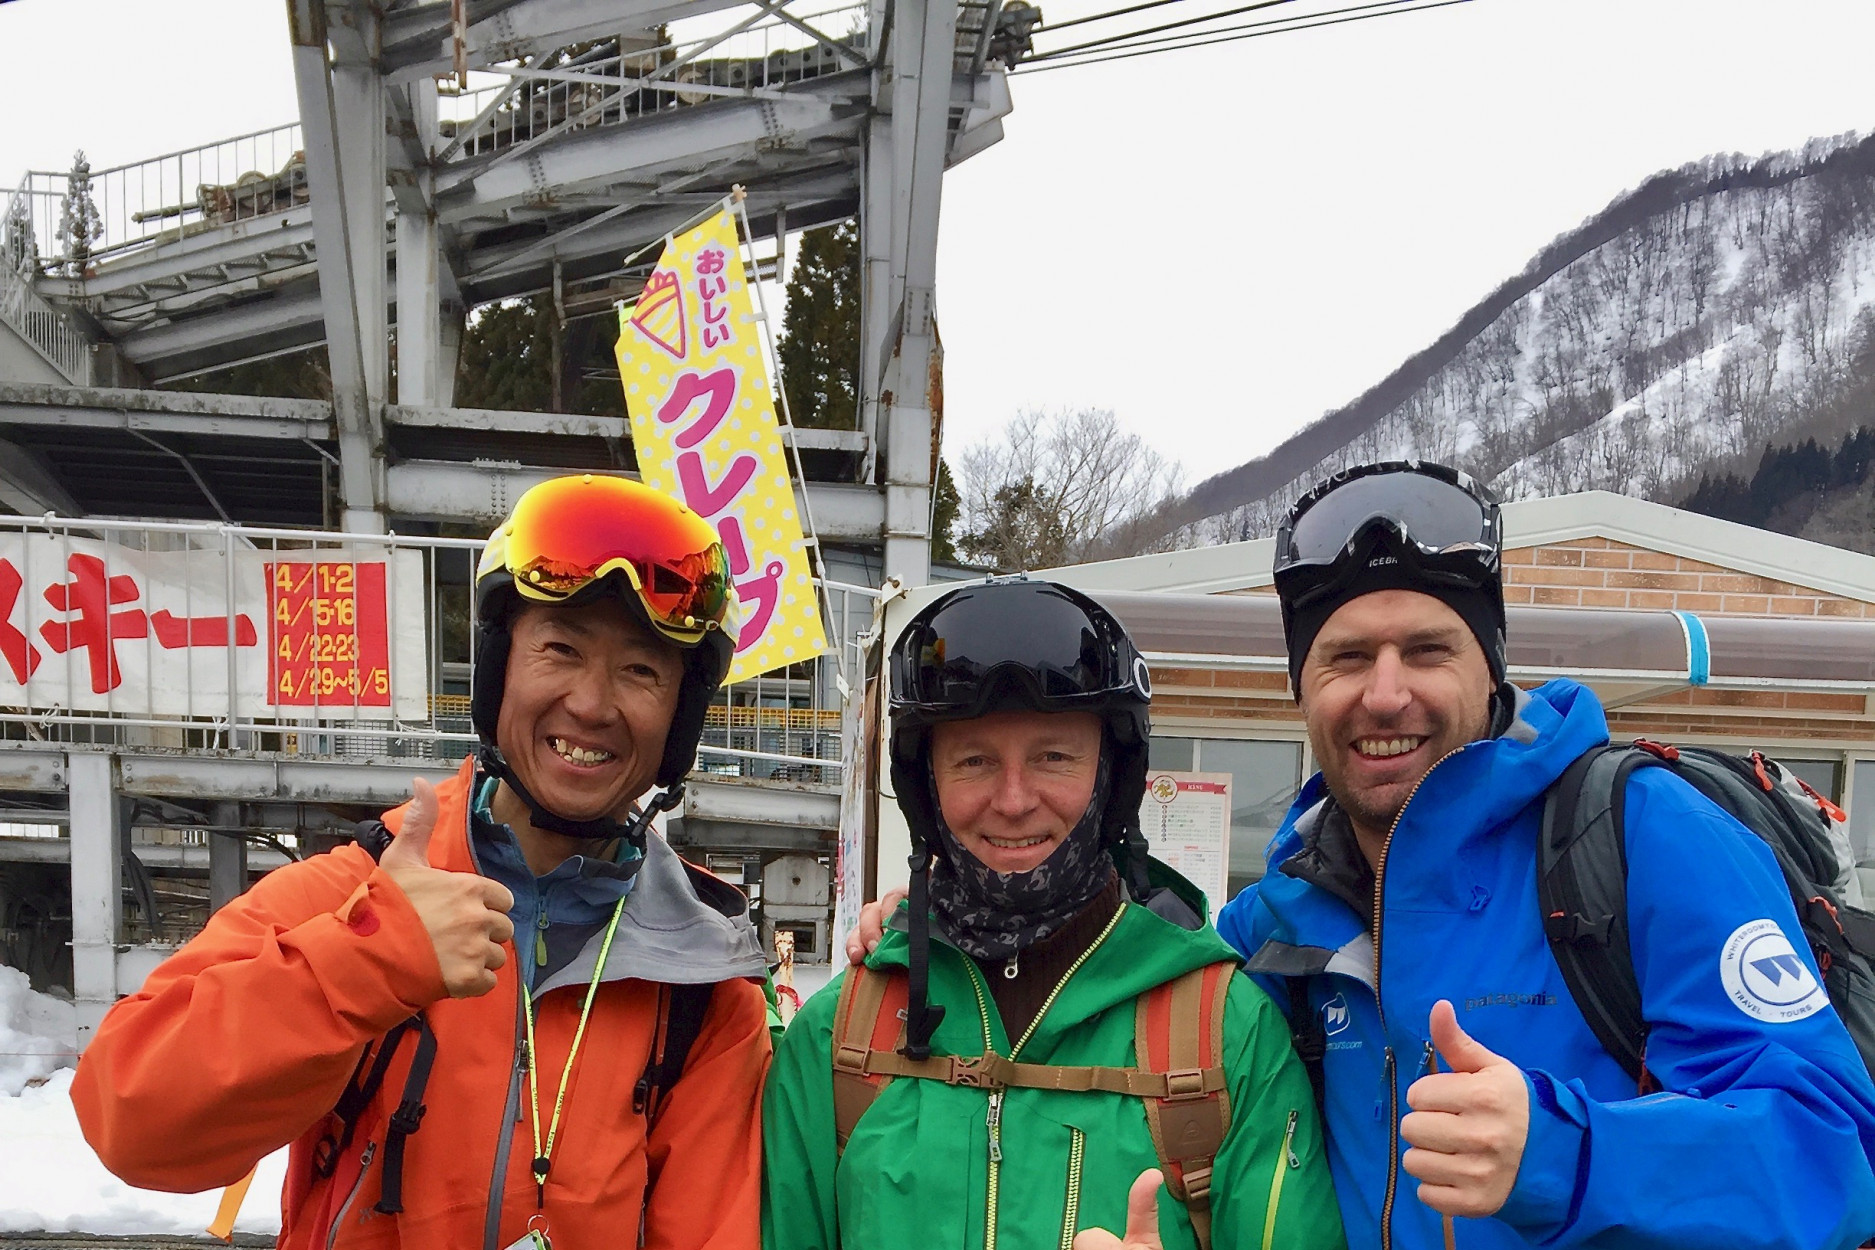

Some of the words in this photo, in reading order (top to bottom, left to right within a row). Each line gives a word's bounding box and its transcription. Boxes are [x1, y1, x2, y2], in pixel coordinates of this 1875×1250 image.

[696, 248, 731, 348] おいしい
[1465, 991, 1558, 1013] patagonia
[1734, 989, 1762, 1014] TRAVEL
[1780, 1004, 1813, 1018] TOURS
